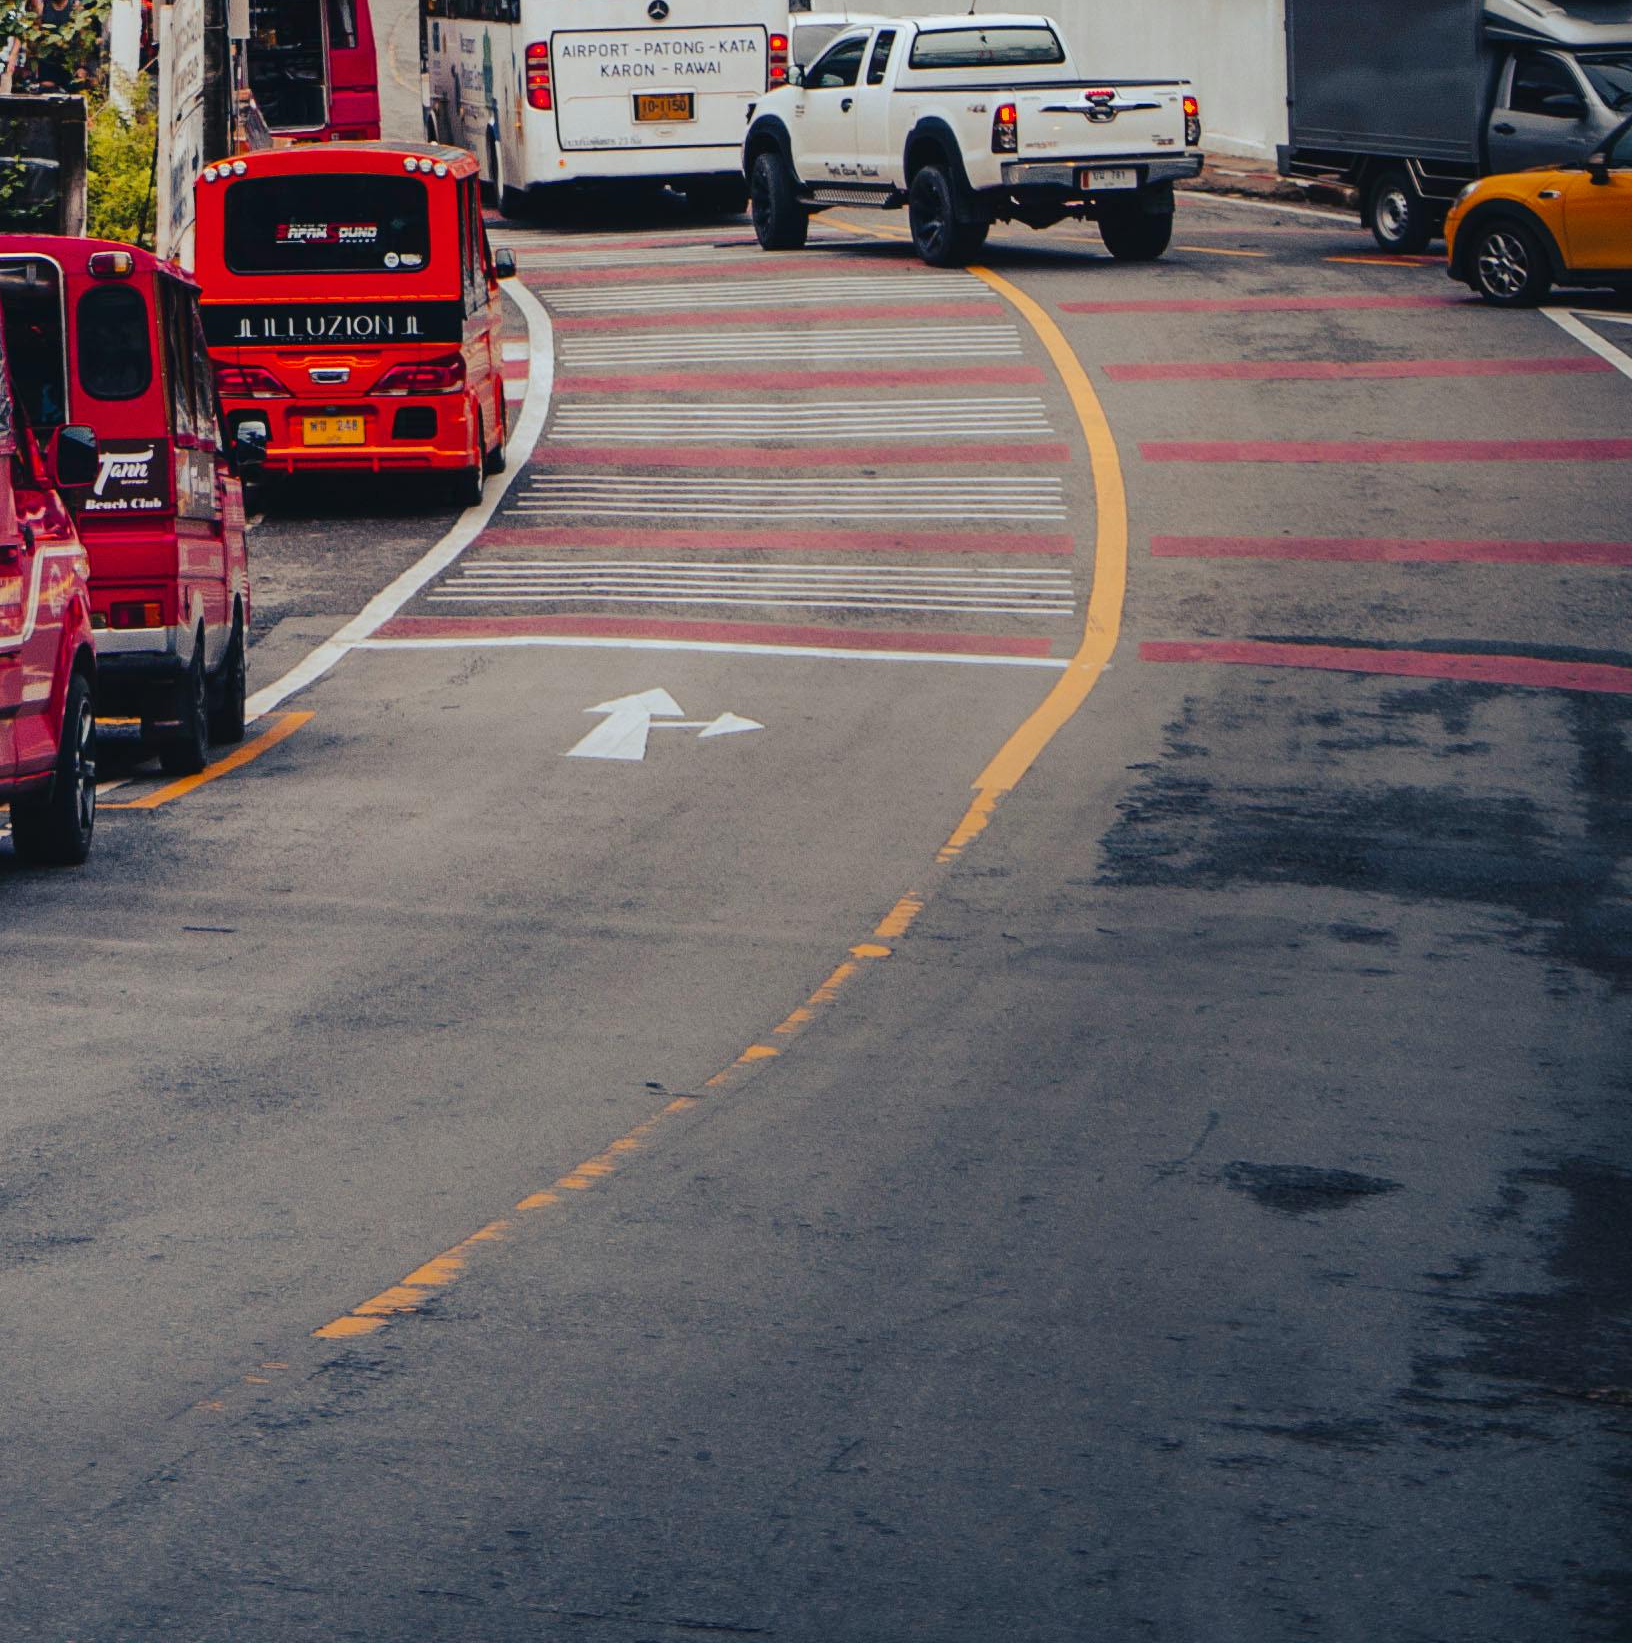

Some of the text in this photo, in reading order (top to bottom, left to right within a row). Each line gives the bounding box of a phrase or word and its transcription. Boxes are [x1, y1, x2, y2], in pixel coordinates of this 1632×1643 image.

[562, 43, 628, 58] AIRPORT
[644, 41, 705, 55] PATONG
[719, 39, 757, 53] KATA
[600, 63, 655, 78] KARON
[675, 61, 721, 75] RAWAI
[264, 315, 394, 338] ILLUZION
[85, 497, 162, 510] Beach Club
